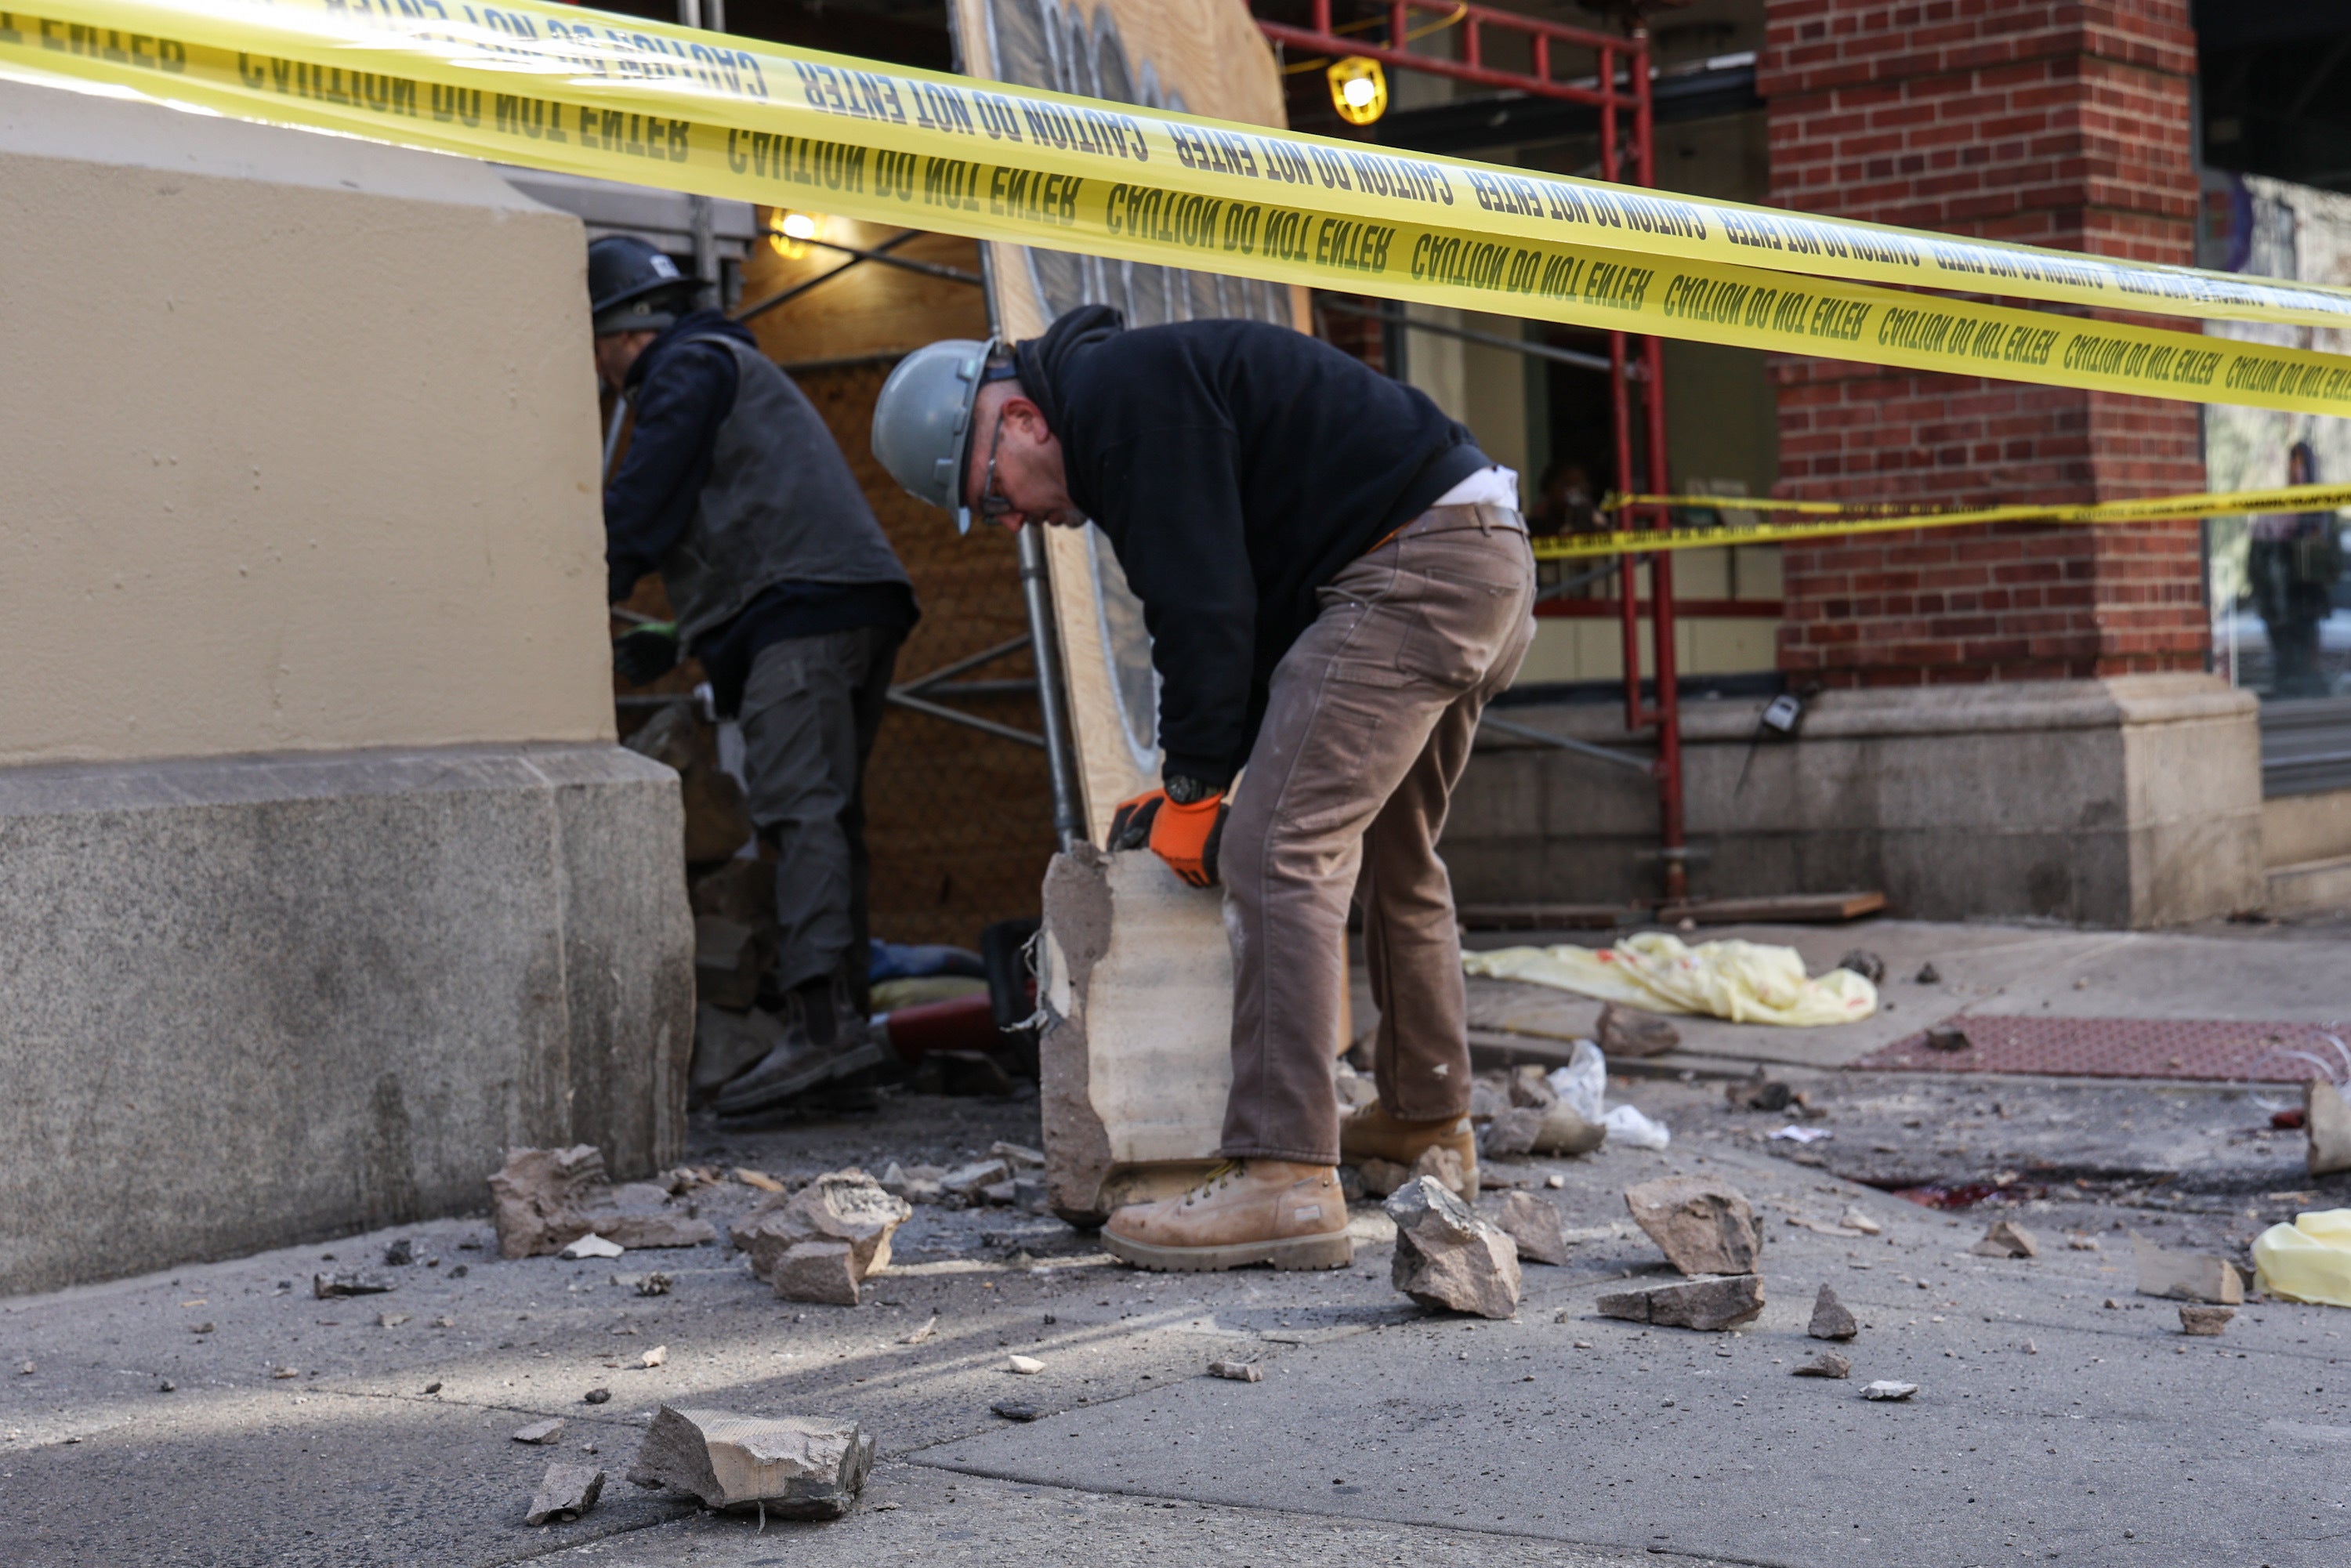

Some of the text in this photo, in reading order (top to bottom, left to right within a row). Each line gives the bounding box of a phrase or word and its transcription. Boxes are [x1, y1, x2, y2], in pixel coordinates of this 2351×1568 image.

[792, 61, 1149, 162] CAUTION DO NOT ENTER
[1164, 122, 1454, 205] CAUTION DO NOT ENTER
[1463, 170, 1707, 240] CAUTION DO NOT ENTER
[1714, 208, 1920, 267] CAUTION DO NOT ENTER
